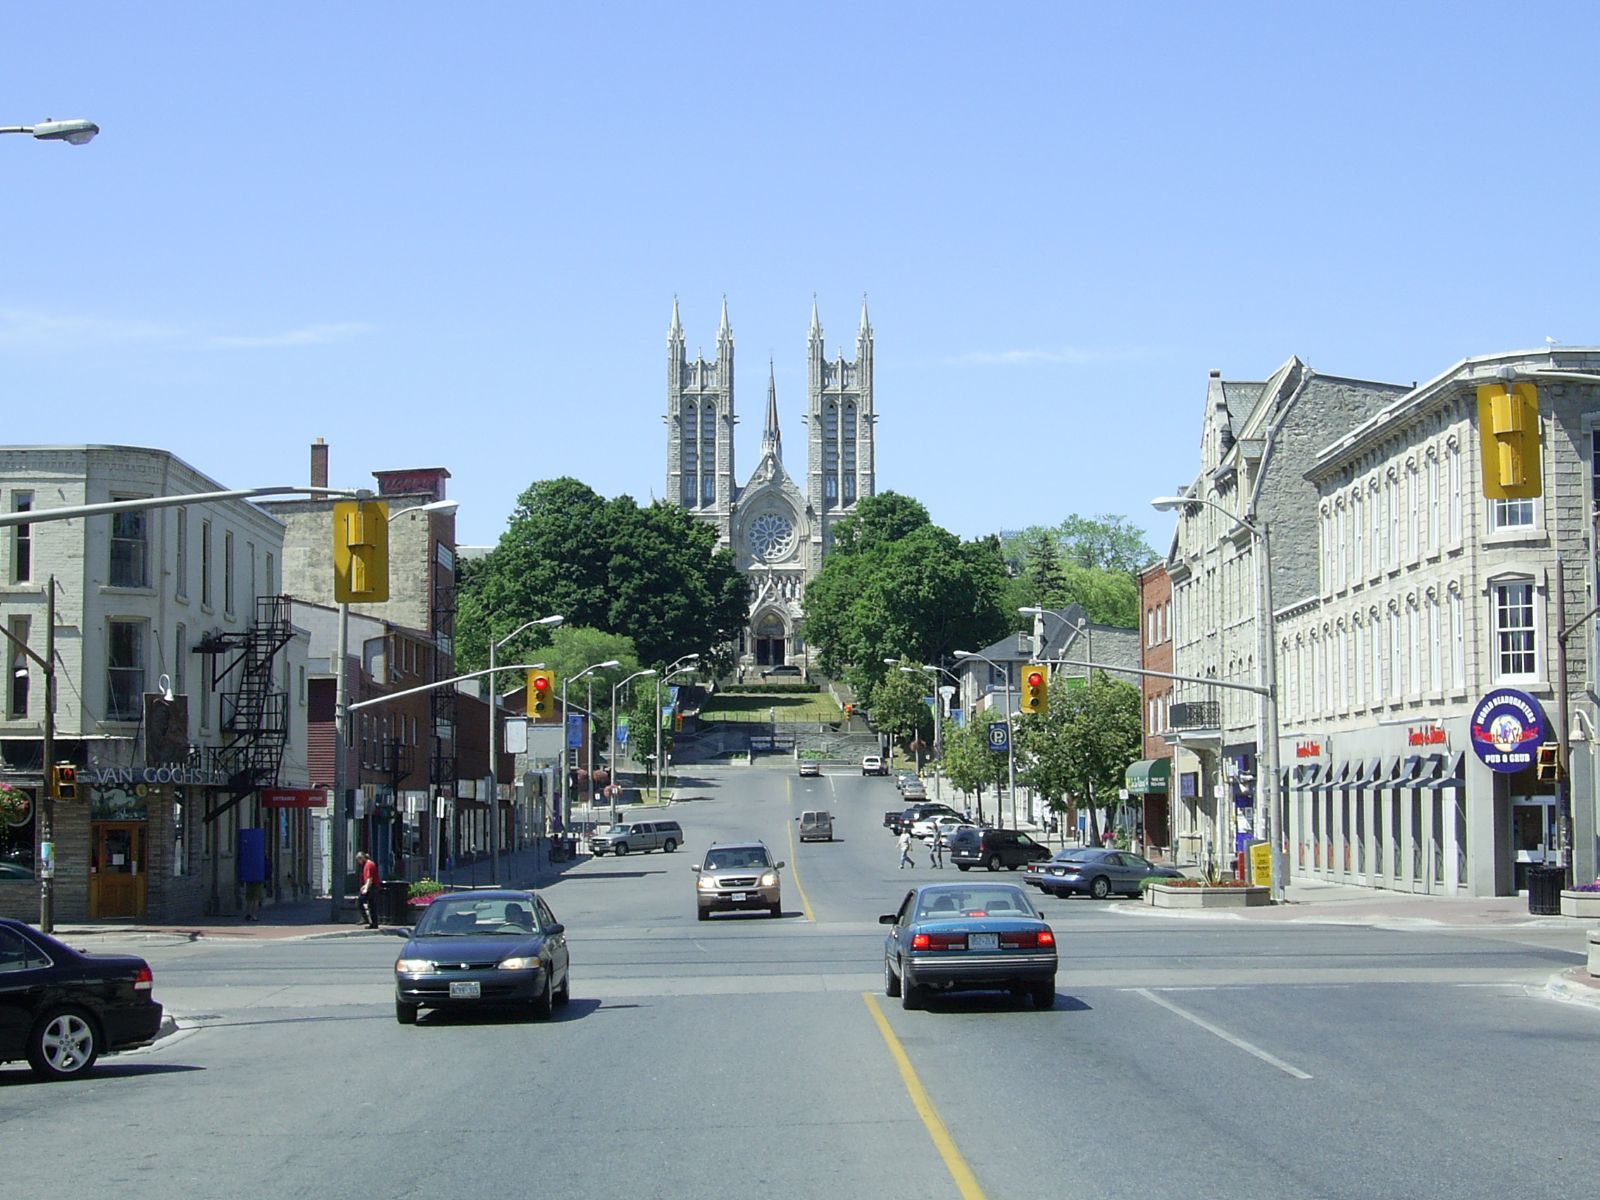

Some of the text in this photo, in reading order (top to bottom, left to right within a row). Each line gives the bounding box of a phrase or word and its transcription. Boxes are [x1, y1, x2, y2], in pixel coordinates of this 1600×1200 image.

[1476, 695, 1536, 725] WORLD HEADQUARTERS
[1485, 754, 1501, 763] PUB
[1509, 753, 1530, 762] GRUB
[95, 767, 133, 783] VAN
